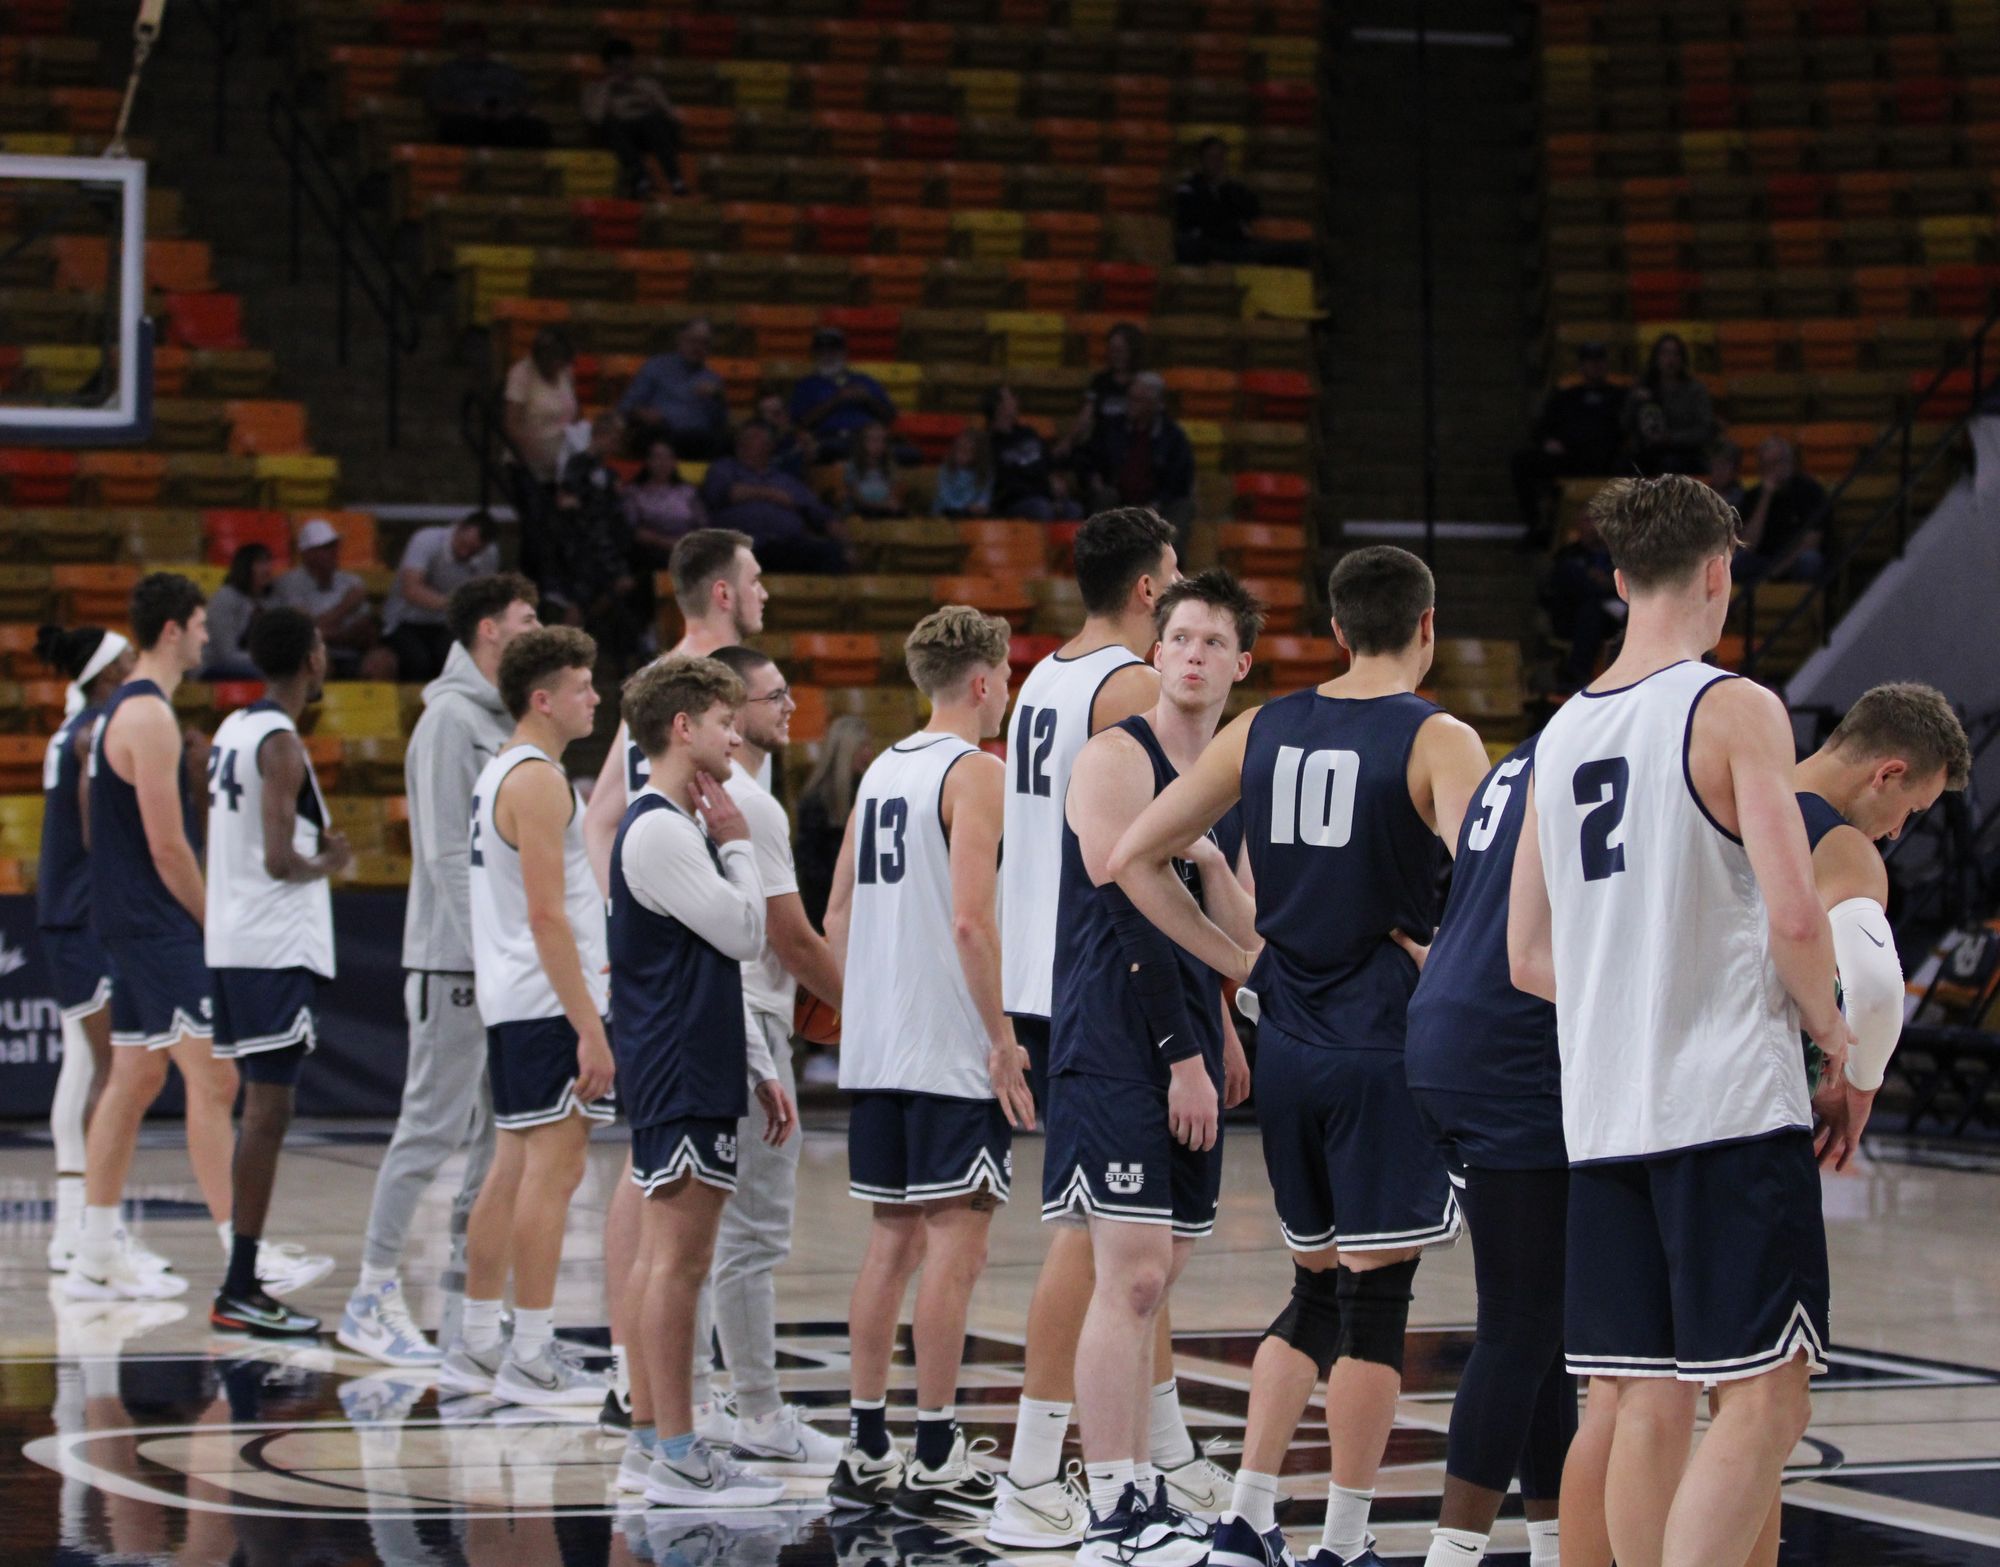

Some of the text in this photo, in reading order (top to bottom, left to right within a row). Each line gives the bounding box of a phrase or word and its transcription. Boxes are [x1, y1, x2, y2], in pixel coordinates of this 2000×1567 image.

[1016, 705, 1058, 797] 12
[1270, 745, 1360, 848] 10
[858, 797, 908, 884] 13
[1468, 757, 1530, 852] 5
[1573, 756, 1630, 882] 2
[1105, 1172, 1144, 1184] STATE
